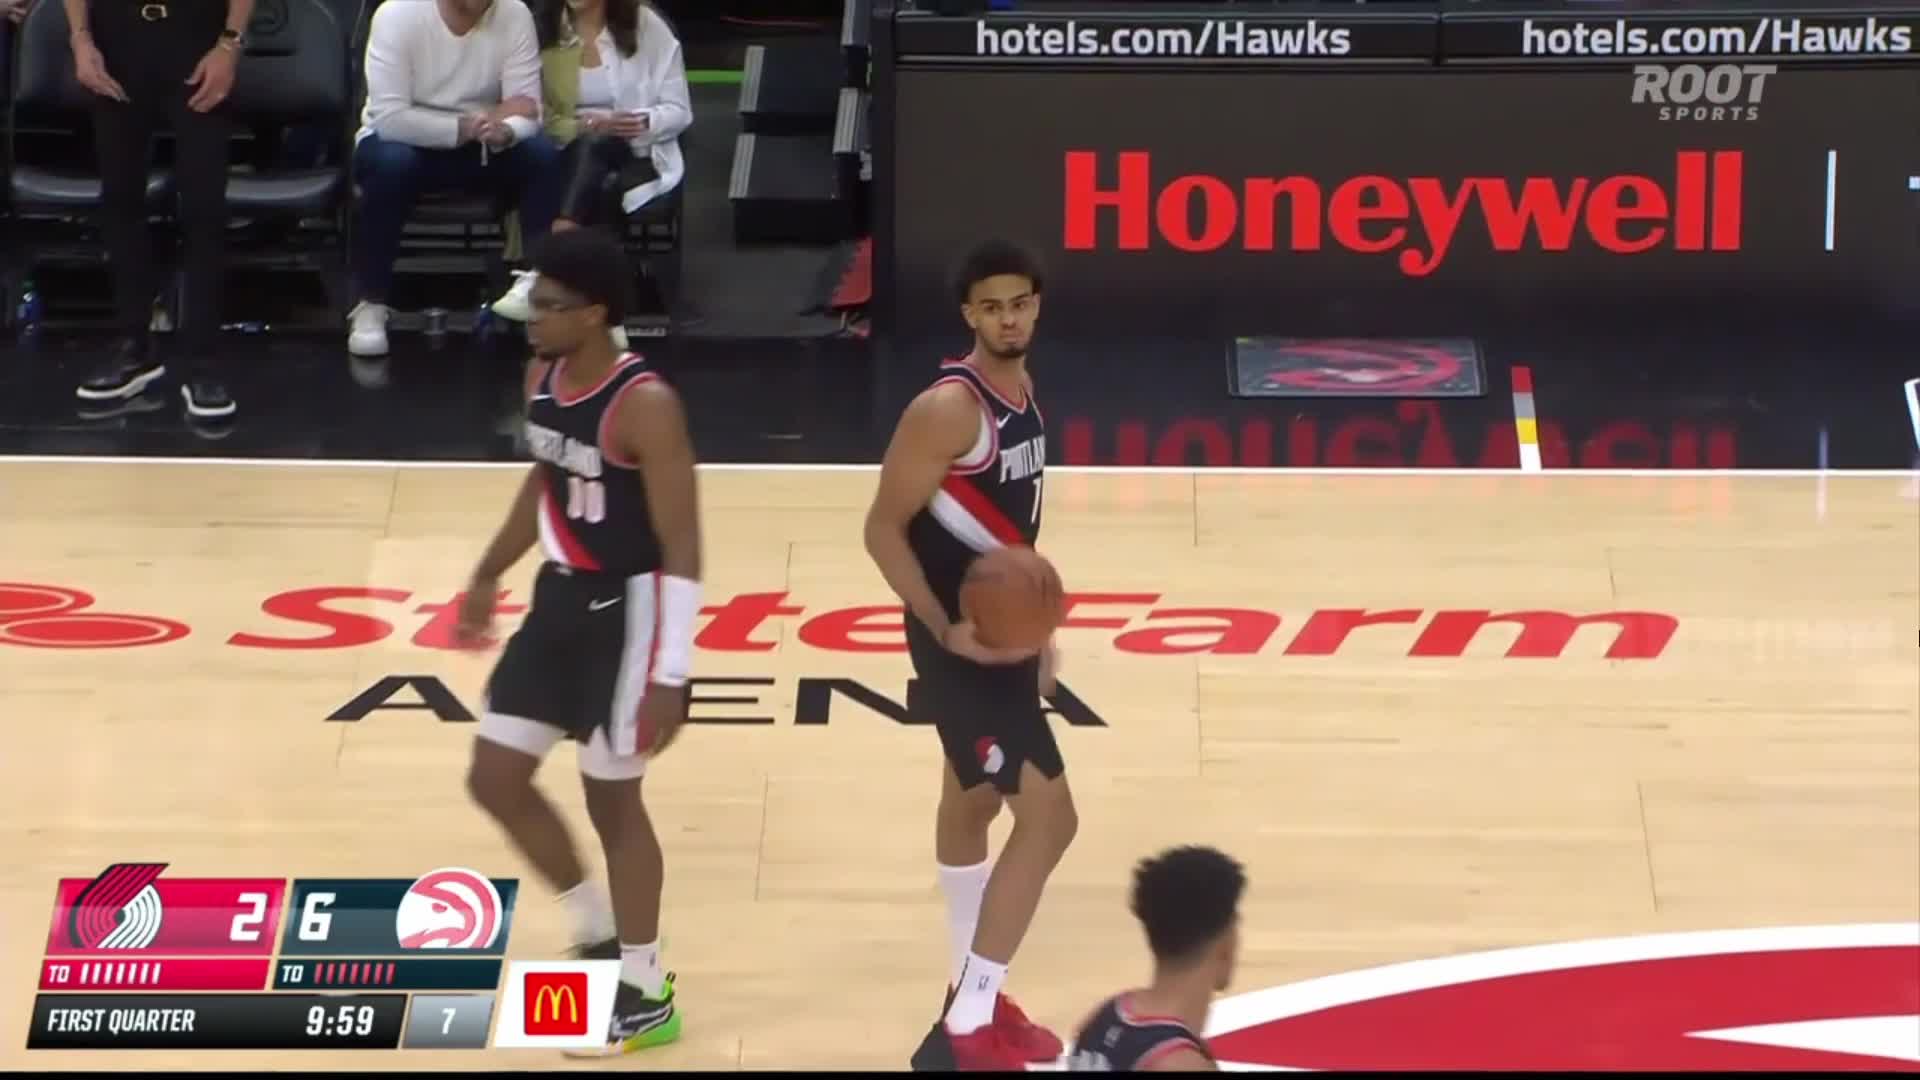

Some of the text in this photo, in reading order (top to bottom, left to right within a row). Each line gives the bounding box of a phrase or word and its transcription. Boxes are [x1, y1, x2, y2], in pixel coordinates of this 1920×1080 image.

[976, 20, 1351, 56] hotels.com/Hawks
[1522, 18, 1912, 54] hotels.com/Hawks
[1064, 151, 1743, 276] Honeywell
[226, 586, 909, 652] Stte
